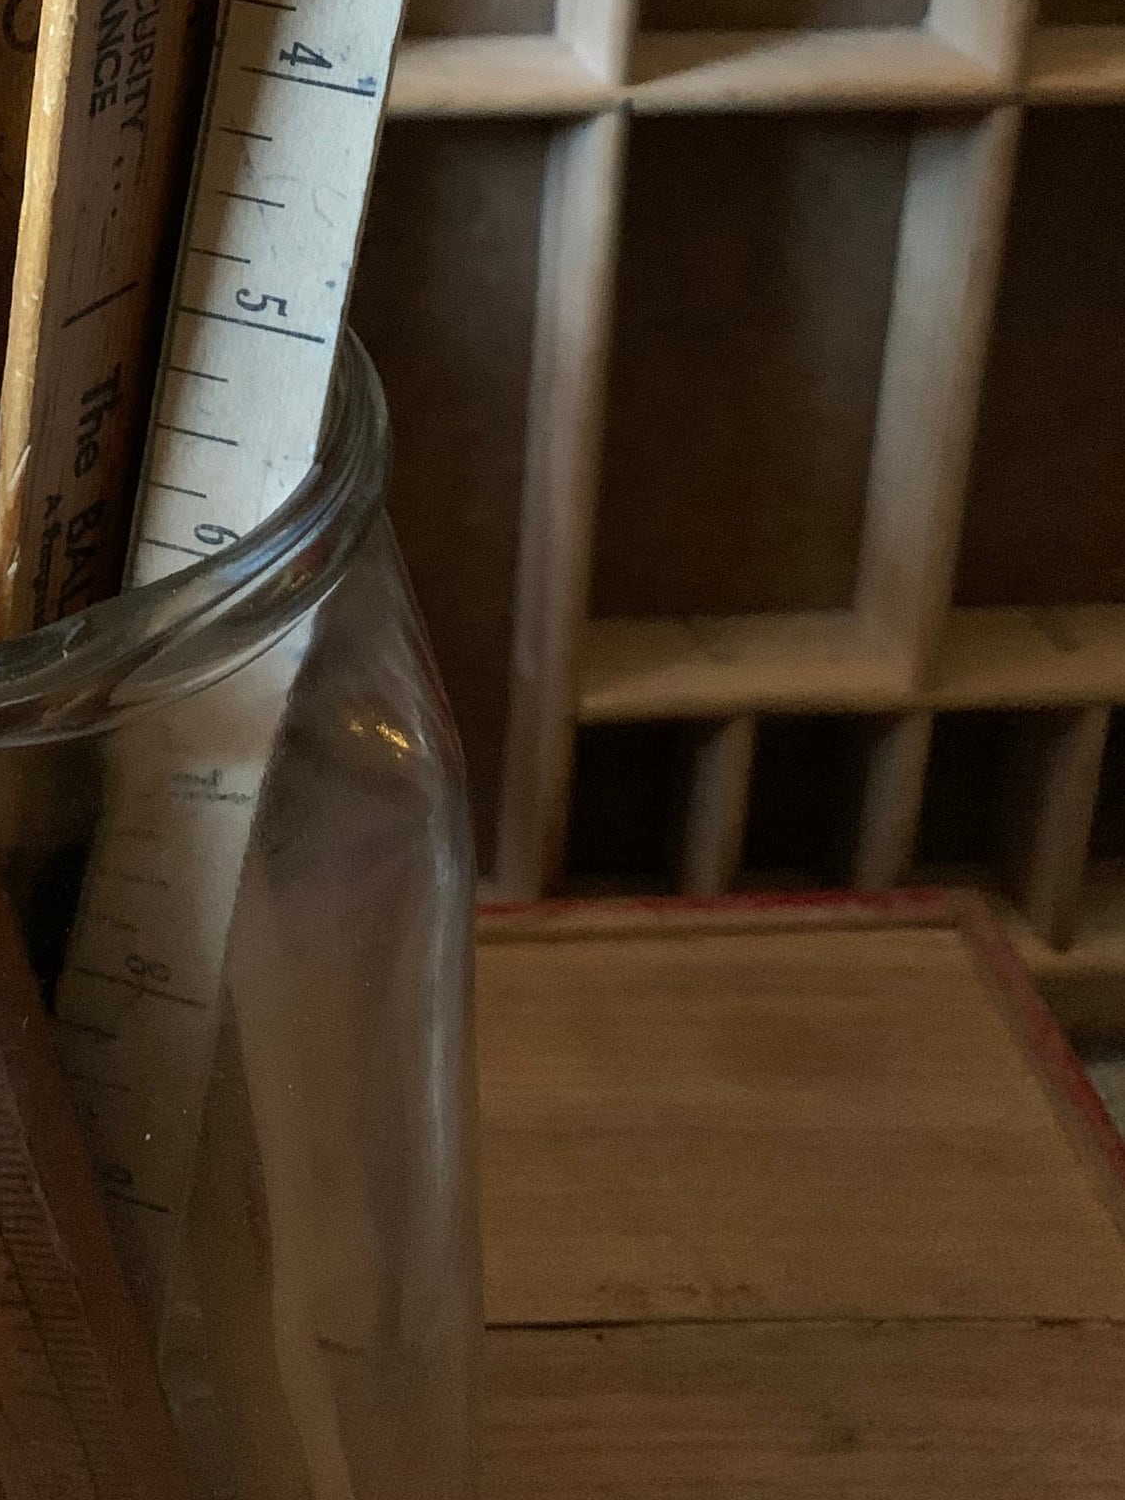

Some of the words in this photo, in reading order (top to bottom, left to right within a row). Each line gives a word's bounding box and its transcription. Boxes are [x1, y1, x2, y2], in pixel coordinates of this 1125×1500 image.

[278, 41, 333, 70] 4
[235, 288, 289, 318] 5
[75, 362, 122, 479] The
[193, 522, 241, 546] 6
[124, 954, 171, 983] 8
